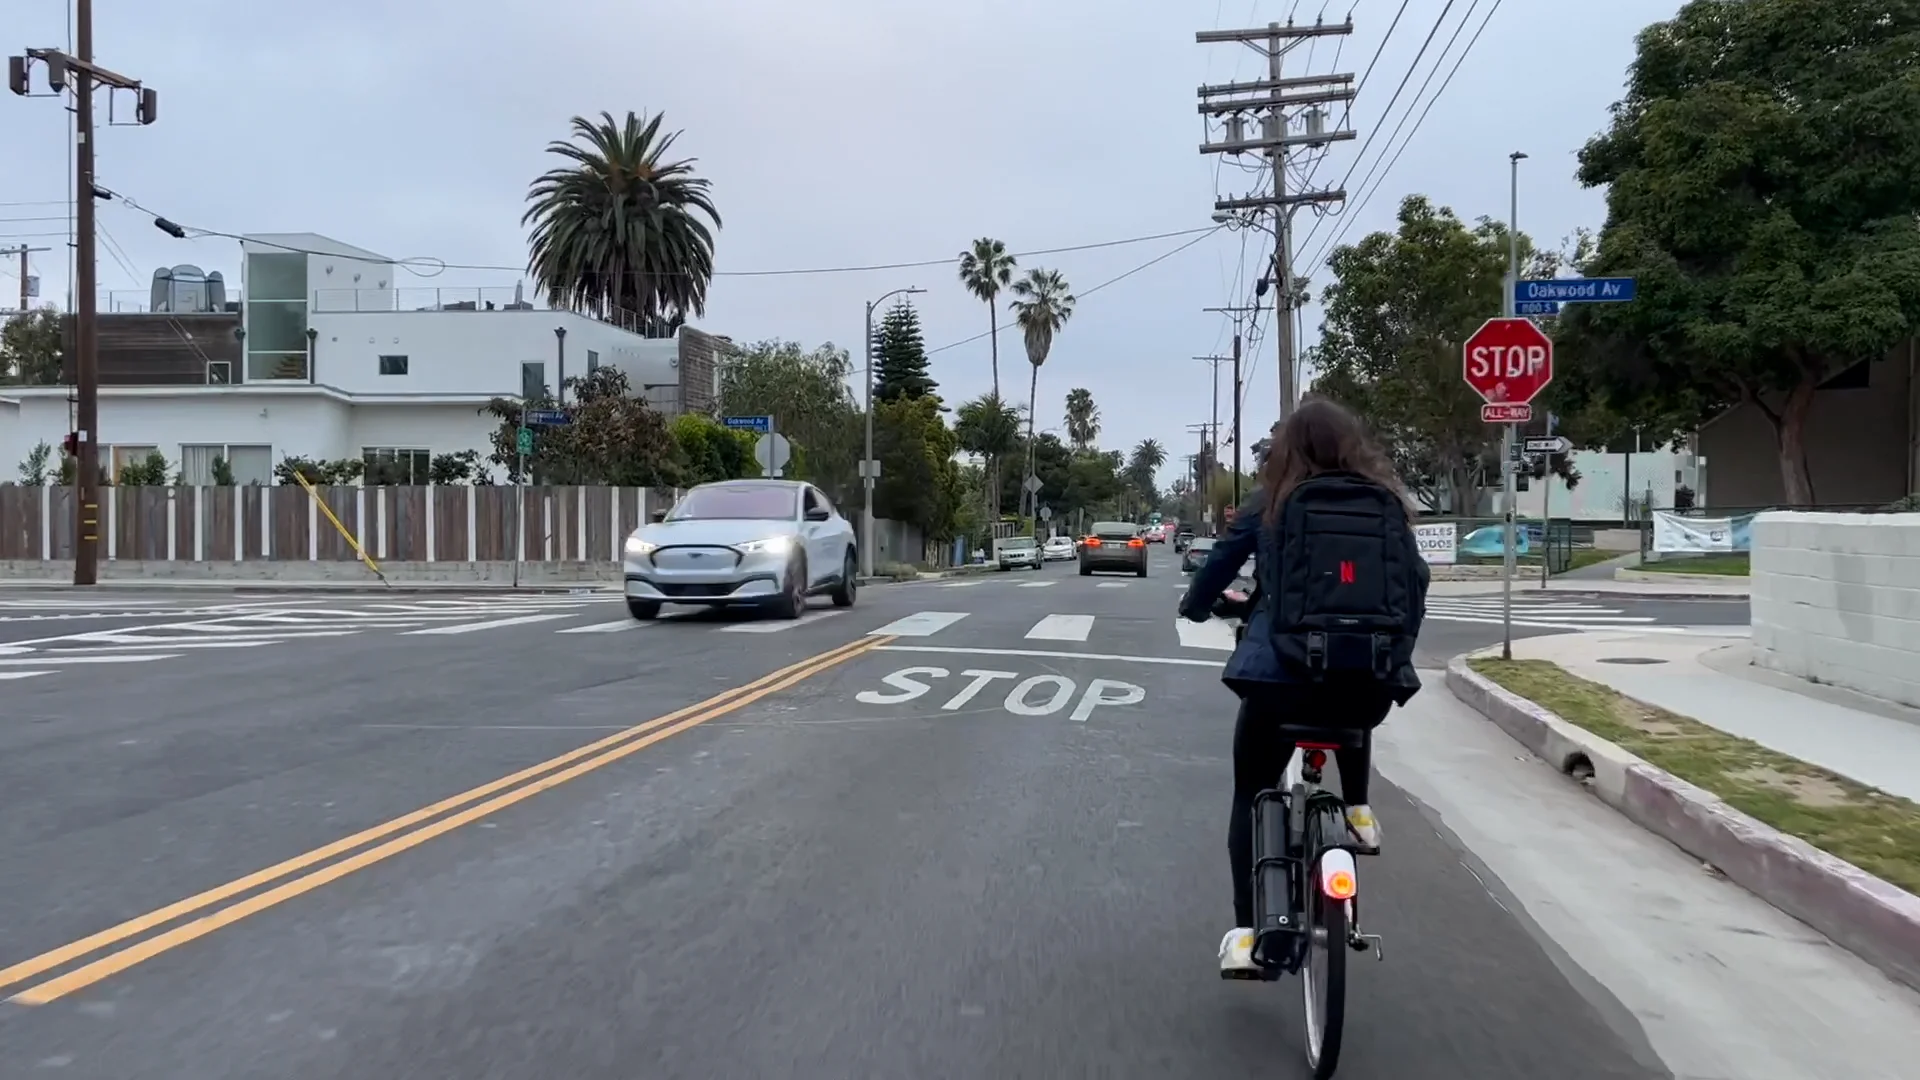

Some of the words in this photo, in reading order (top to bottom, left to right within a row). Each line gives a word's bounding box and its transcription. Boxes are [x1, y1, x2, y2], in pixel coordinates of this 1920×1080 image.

[1528, 282, 1595, 298] Oakwood
[1602, 283, 1621, 296] Av
[1471, 345, 1545, 377] STOP
[1485, 407, 1528, 418] ALL-WAY
[1417, 527, 1453, 536] GELES
[1340, 560, 1355, 584] N
[855, 666, 1146, 722] STOP
